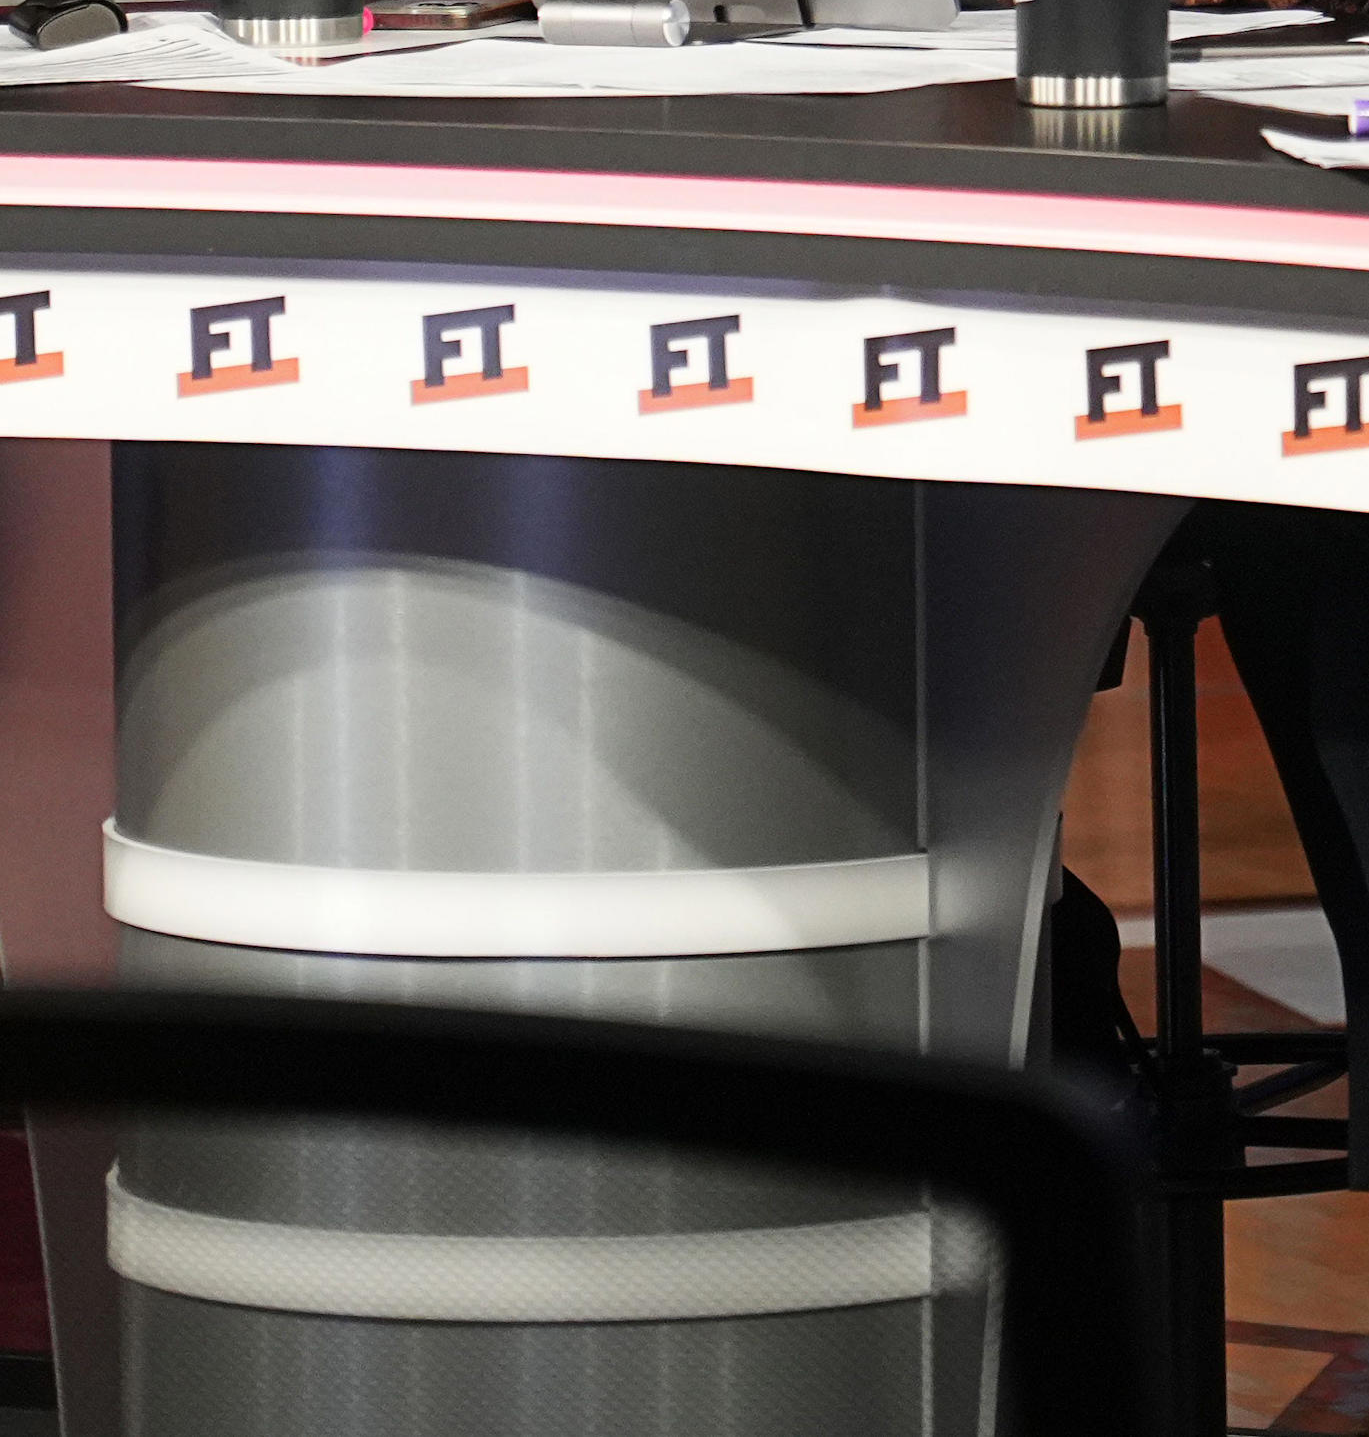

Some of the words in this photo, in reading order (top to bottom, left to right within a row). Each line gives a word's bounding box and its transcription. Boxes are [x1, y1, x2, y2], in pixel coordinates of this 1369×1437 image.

[190, 297, 285, 379] FT
[422, 304, 515, 387] FT
[650, 315, 740, 396] FT
[864, 328, 955, 410] FT
[1086, 341, 1169, 422] FT
